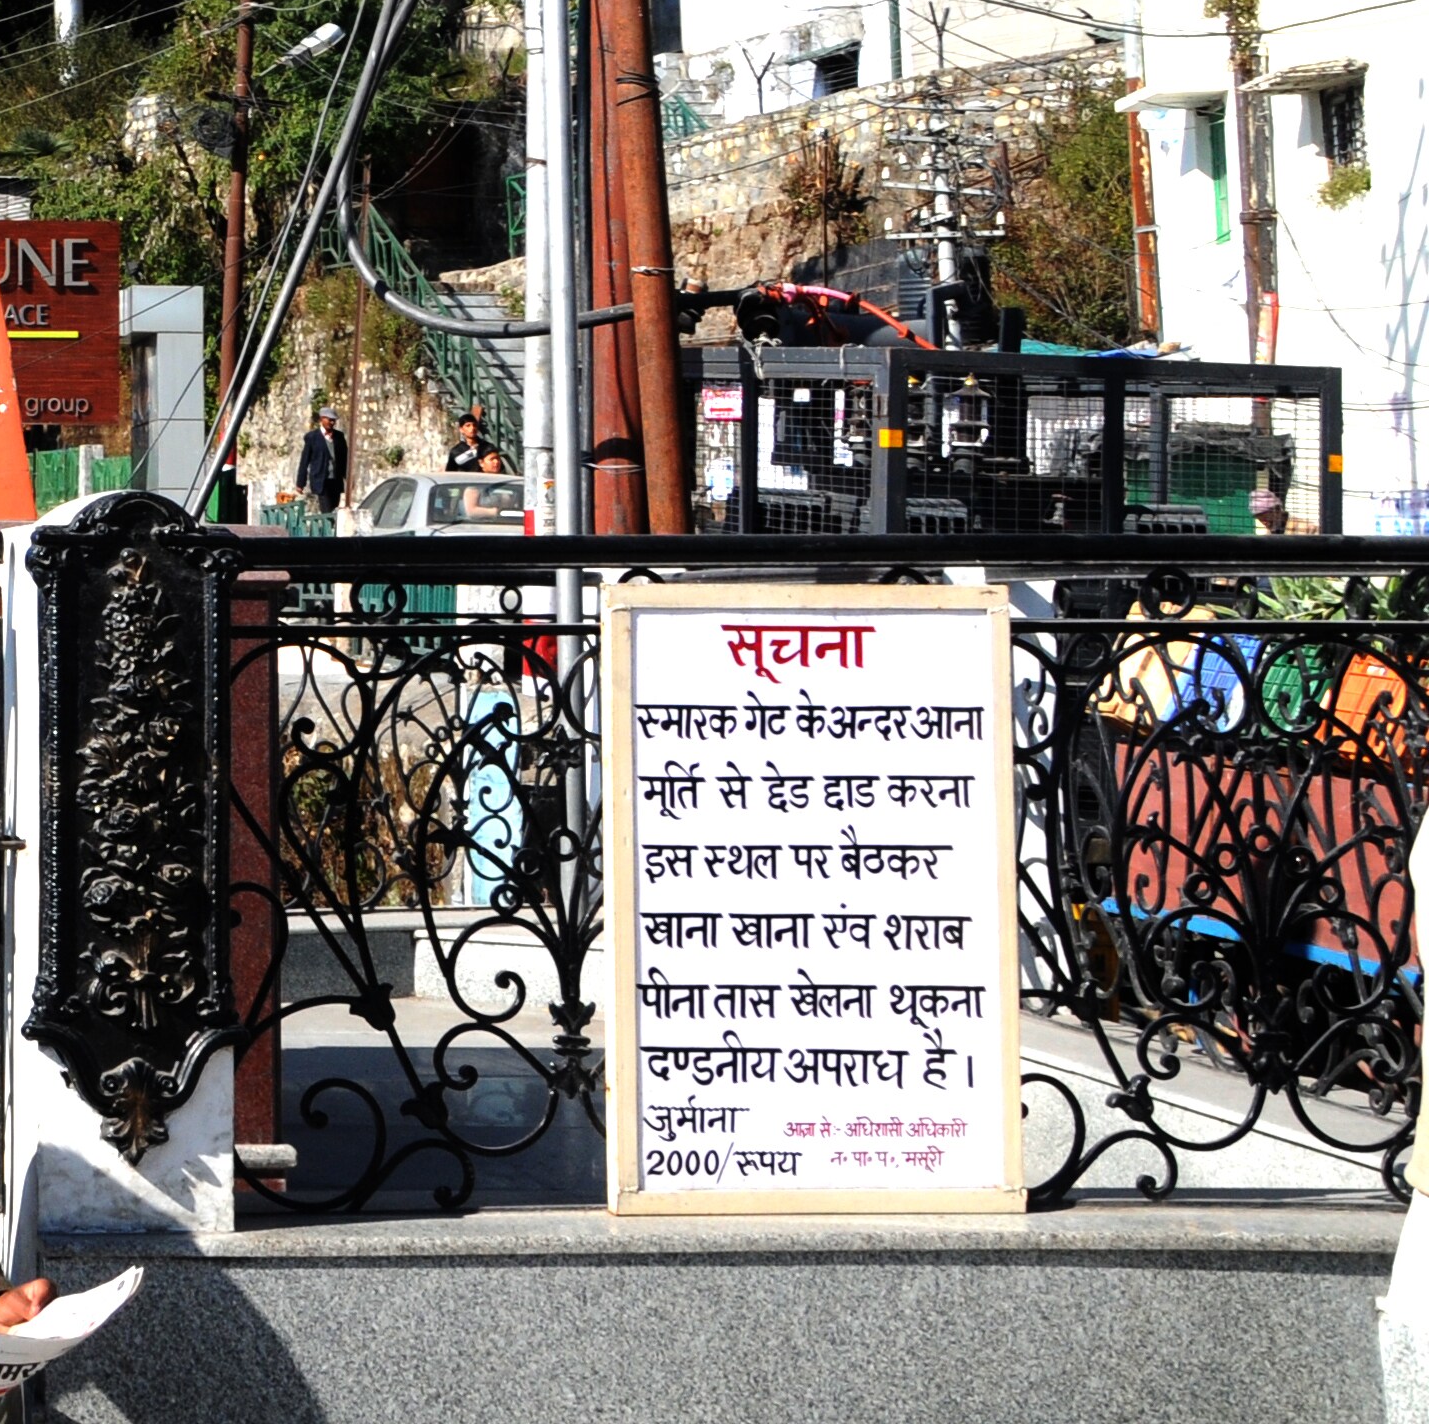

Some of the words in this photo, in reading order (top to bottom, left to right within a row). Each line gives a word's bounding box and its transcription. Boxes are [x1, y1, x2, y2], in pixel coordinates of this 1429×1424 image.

[24, 395, 90, 417] group
[721, 624, 876, 684] सूचना
[635, 704, 738, 740] स्मारक
[743, 690, 792, 740] गेट
[638, 760, 706, 820] मूर्ति
[715, 760, 753, 810] से
[887, 775, 975, 808] करना
[642, 844, 699, 884] इस
[704, 844, 783, 880] स्थल
[788, 844, 833, 879] पर
[839, 824, 953, 880] बैठकर
[640, 912, 723, 949] खाना
[728, 913, 815, 949] खाना
[883, 914, 972, 951] शराब
[636, 966, 710, 1019] पीना
[714, 984, 782, 1018] तास
[788, 968, 877, 1018] खेलना
[889, 984, 986, 1029] थूकना
[639, 1029, 783, 1086] दण्डनीय
[784, 1048, 910, 1089] अपराध
[643, 1094, 750, 1142] जुर्माना
[906, 1117, 968, 1139] अधिकारी
